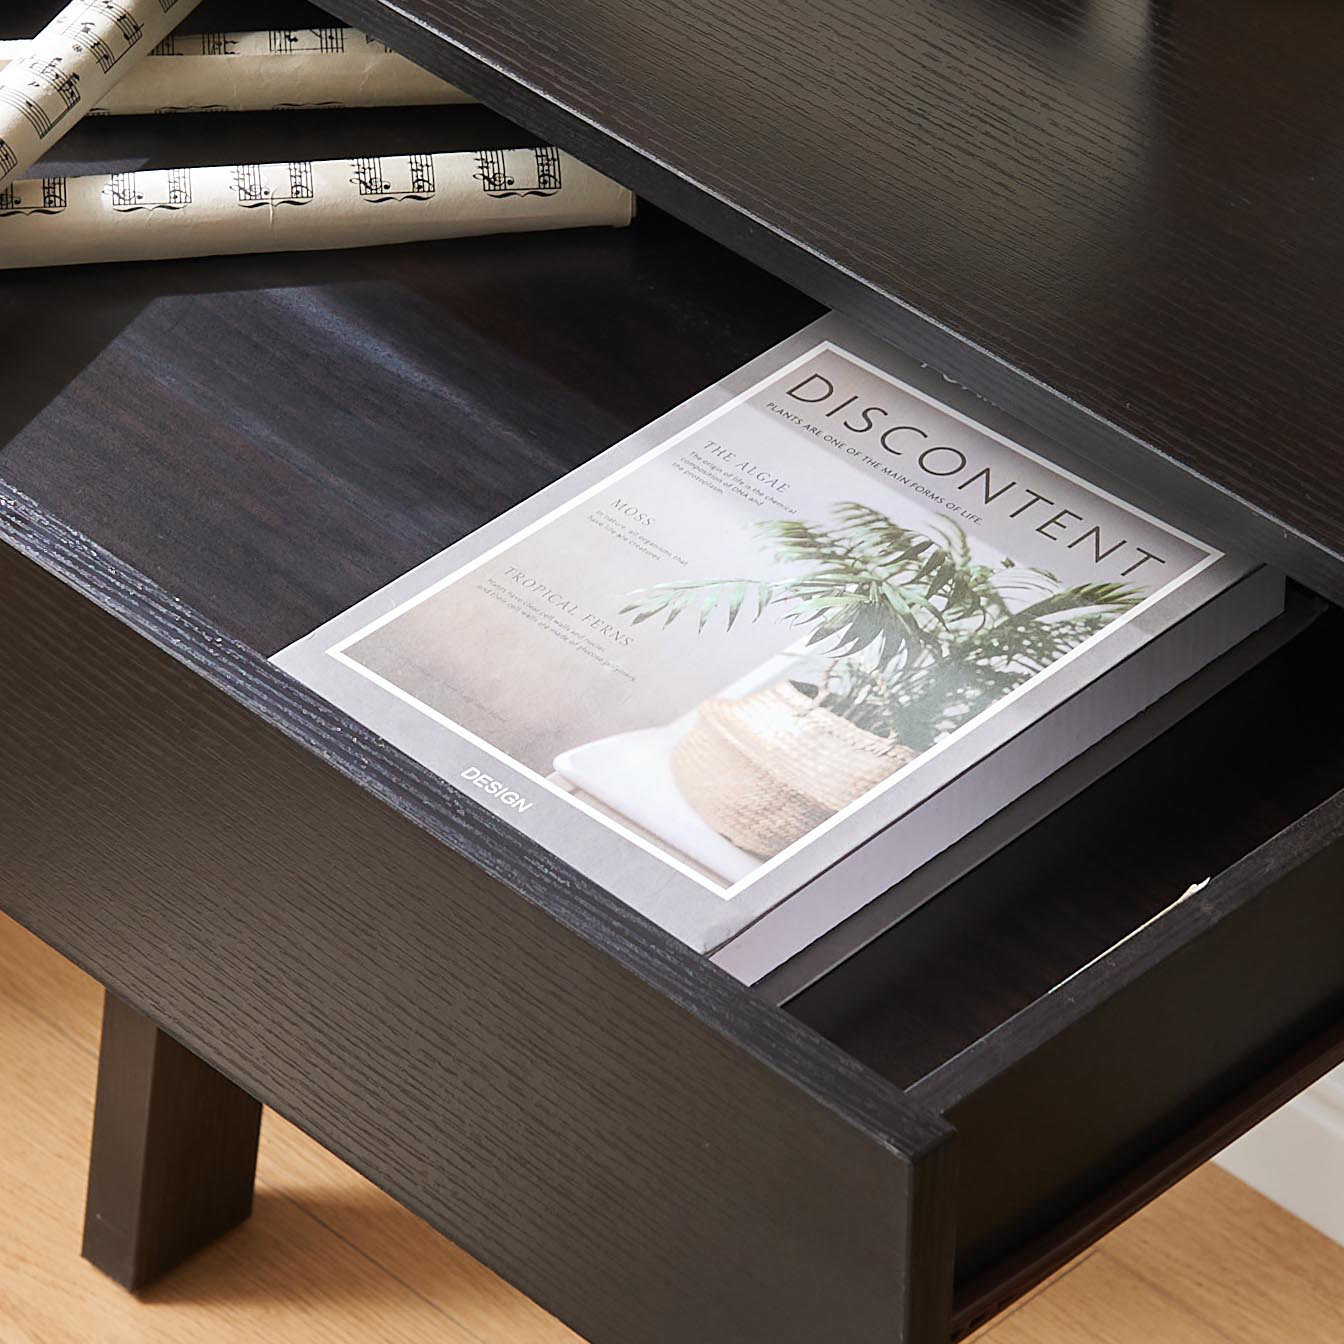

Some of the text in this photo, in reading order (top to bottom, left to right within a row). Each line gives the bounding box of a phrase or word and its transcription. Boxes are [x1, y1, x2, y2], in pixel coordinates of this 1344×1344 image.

[680, 457, 723, 484] composition
[731, 486, 749, 499] DNA
[748, 497, 764, 507] and
[689, 450, 703, 461] The
[702, 459, 723, 473] origin
[731, 476, 745, 486] life
[752, 487, 765, 497] the
[764, 495, 798, 514] chemical
[703, 440, 791, 493] THE ALGAE
[765, 402, 983, 526] PLANTS ARE ONE OF THE MAIN FORMS OF LIFE.
[785, 372, 1166, 578] DISCONTENT
[610, 498, 656, 526] MOSS
[504, 566, 634, 646] TROPICAL FERNS
[460, 766, 534, 813] DESIGN
